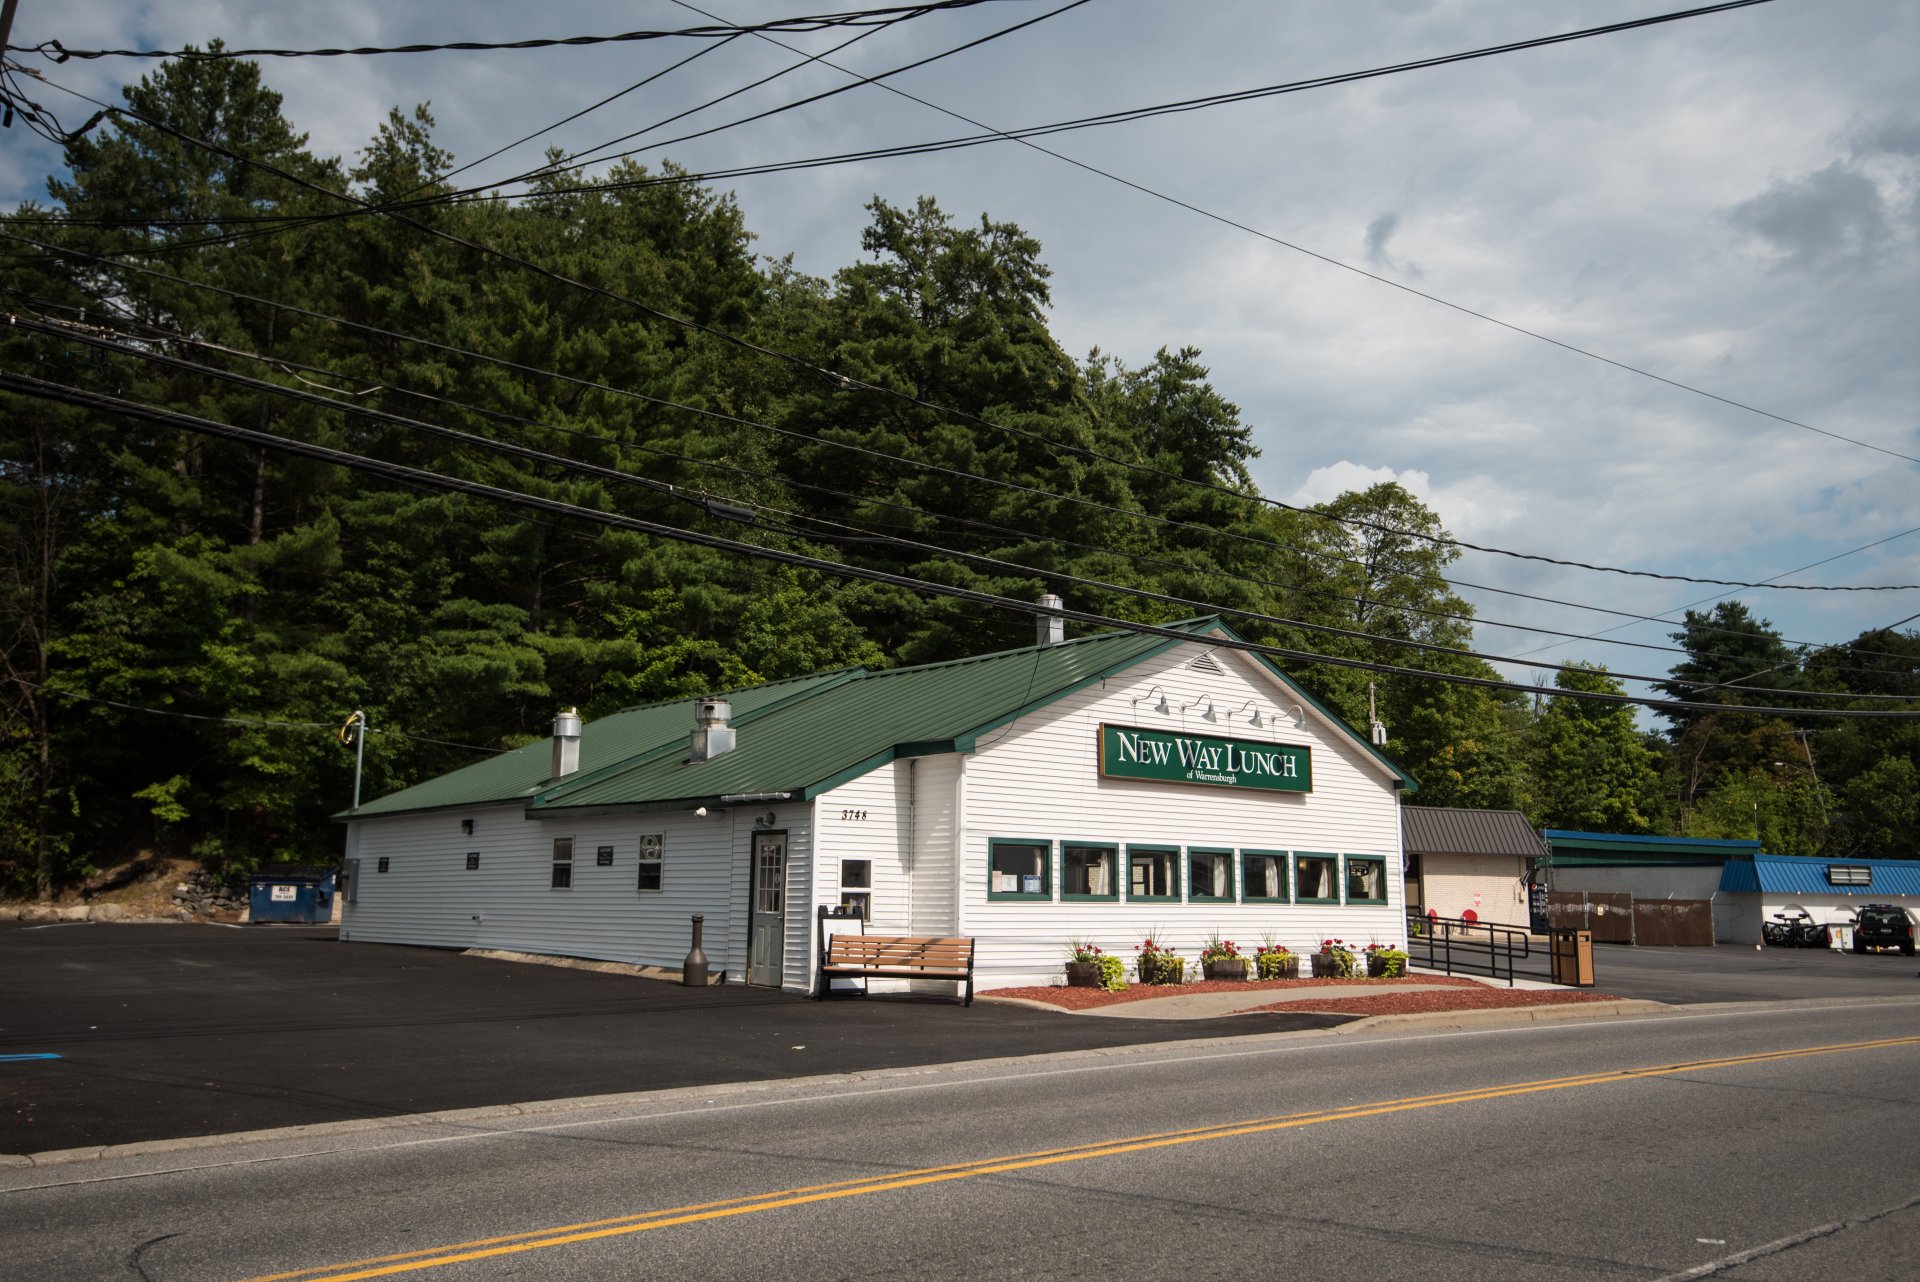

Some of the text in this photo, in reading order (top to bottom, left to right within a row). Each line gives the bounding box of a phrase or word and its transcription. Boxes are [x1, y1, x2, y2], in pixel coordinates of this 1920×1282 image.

[1117, 732, 1298, 778] NEW WAY LUNCH
[1186, 770, 1237, 784] of Warrensburgh
[841, 809, 868, 821] 3748
